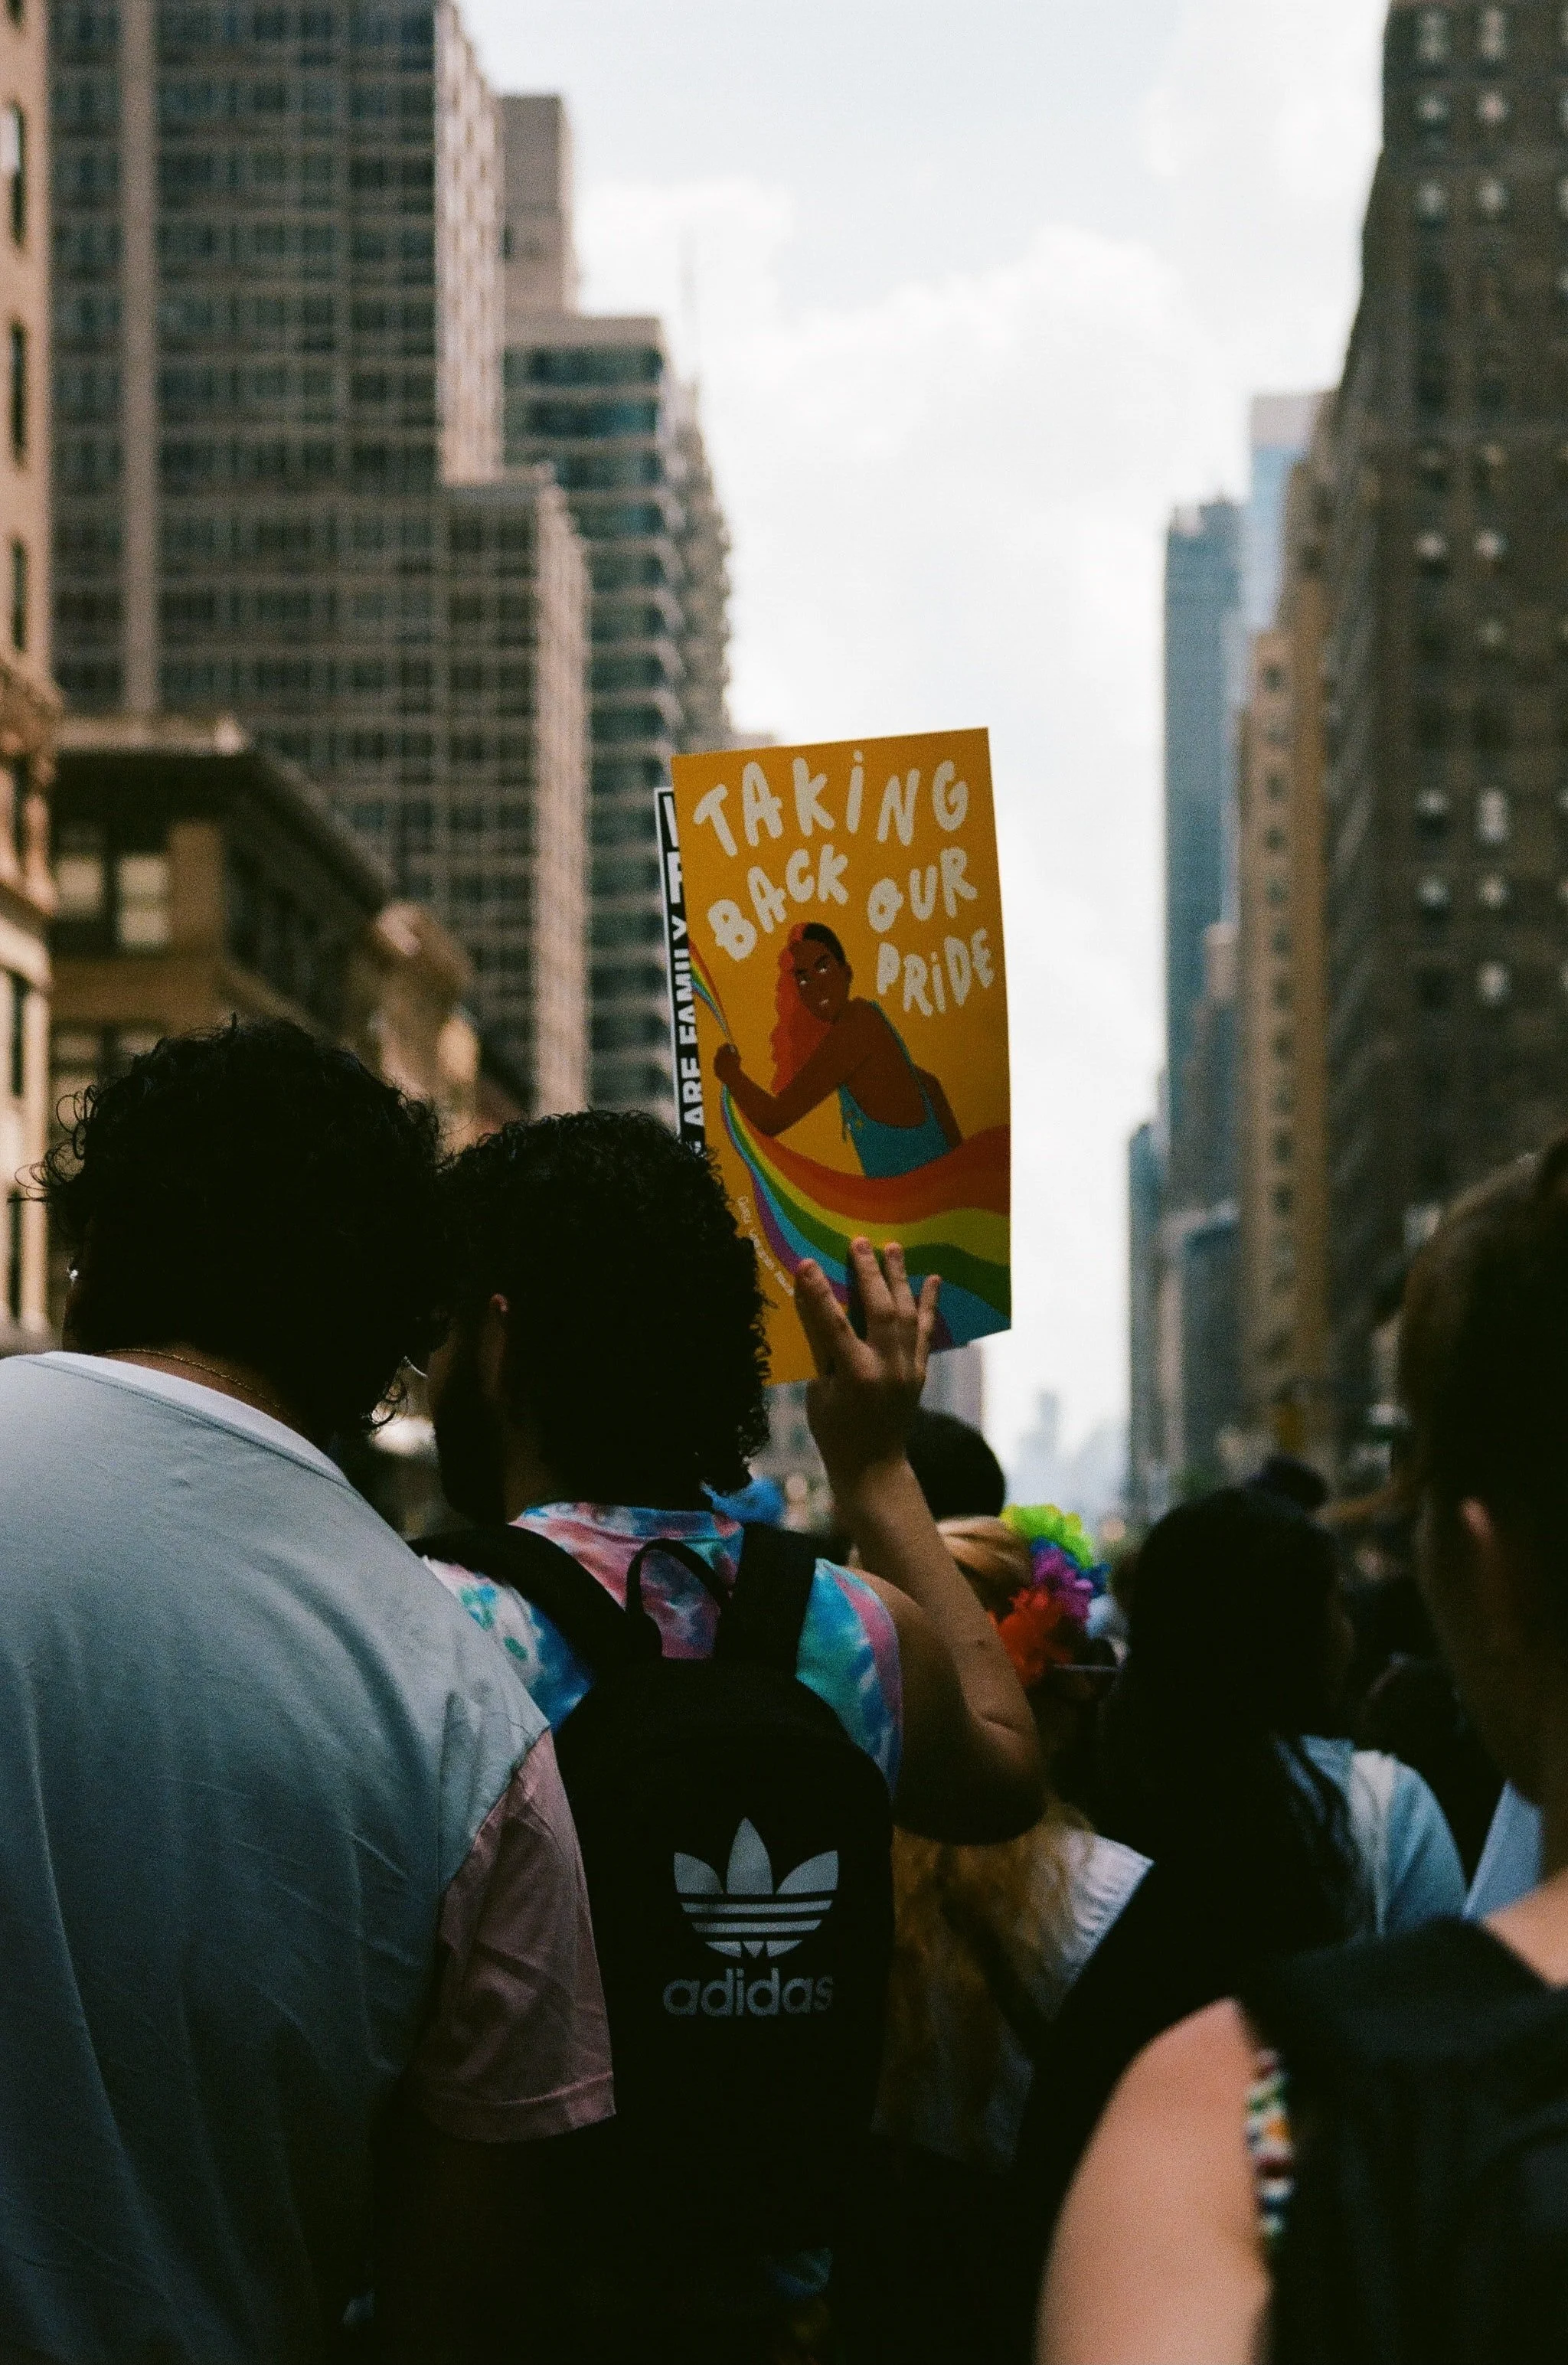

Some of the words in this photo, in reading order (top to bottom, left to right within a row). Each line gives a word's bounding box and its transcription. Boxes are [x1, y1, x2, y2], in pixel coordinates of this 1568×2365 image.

[707, 844, 850, 962] BACK
[867, 847, 978, 933] OUR
[662, 1967, 835, 2016] adidas
